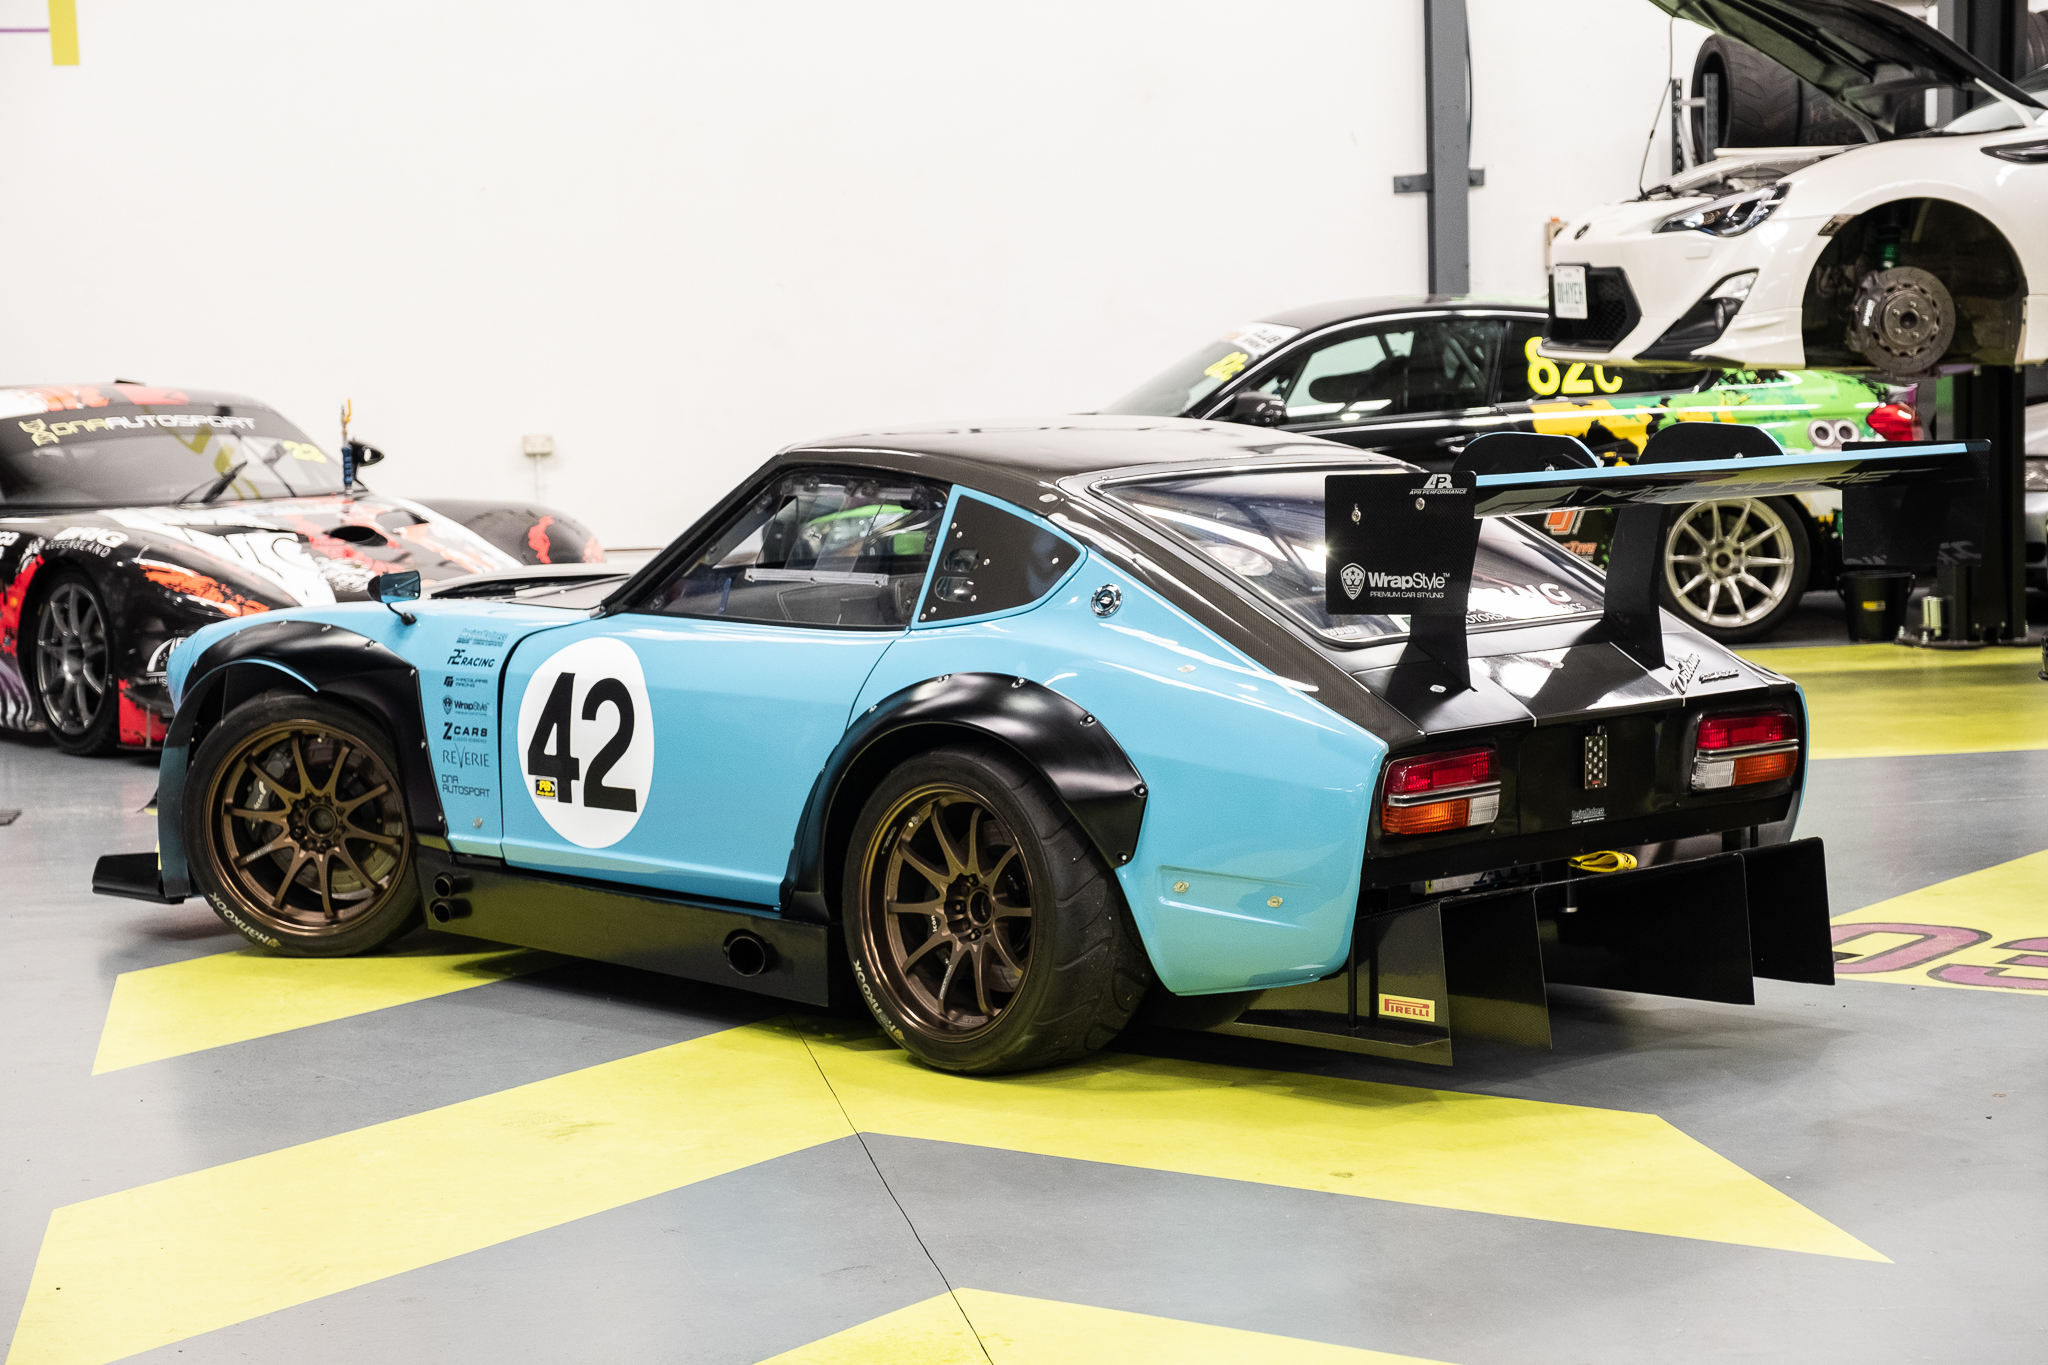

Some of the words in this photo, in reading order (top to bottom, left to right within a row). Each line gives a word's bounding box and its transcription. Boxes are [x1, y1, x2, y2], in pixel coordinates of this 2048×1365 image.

[1417, 591, 1444, 599] STYLING
[461, 657, 495, 668] RACING
[443, 722, 453, 740] Z
[454, 726, 488, 737] CARS
[528, 672, 637, 813] 42
[442, 774, 458, 784] DNA
[442, 784, 490, 797] AUTOSPORT
[1384, 998, 1430, 1017] PIRELLI
